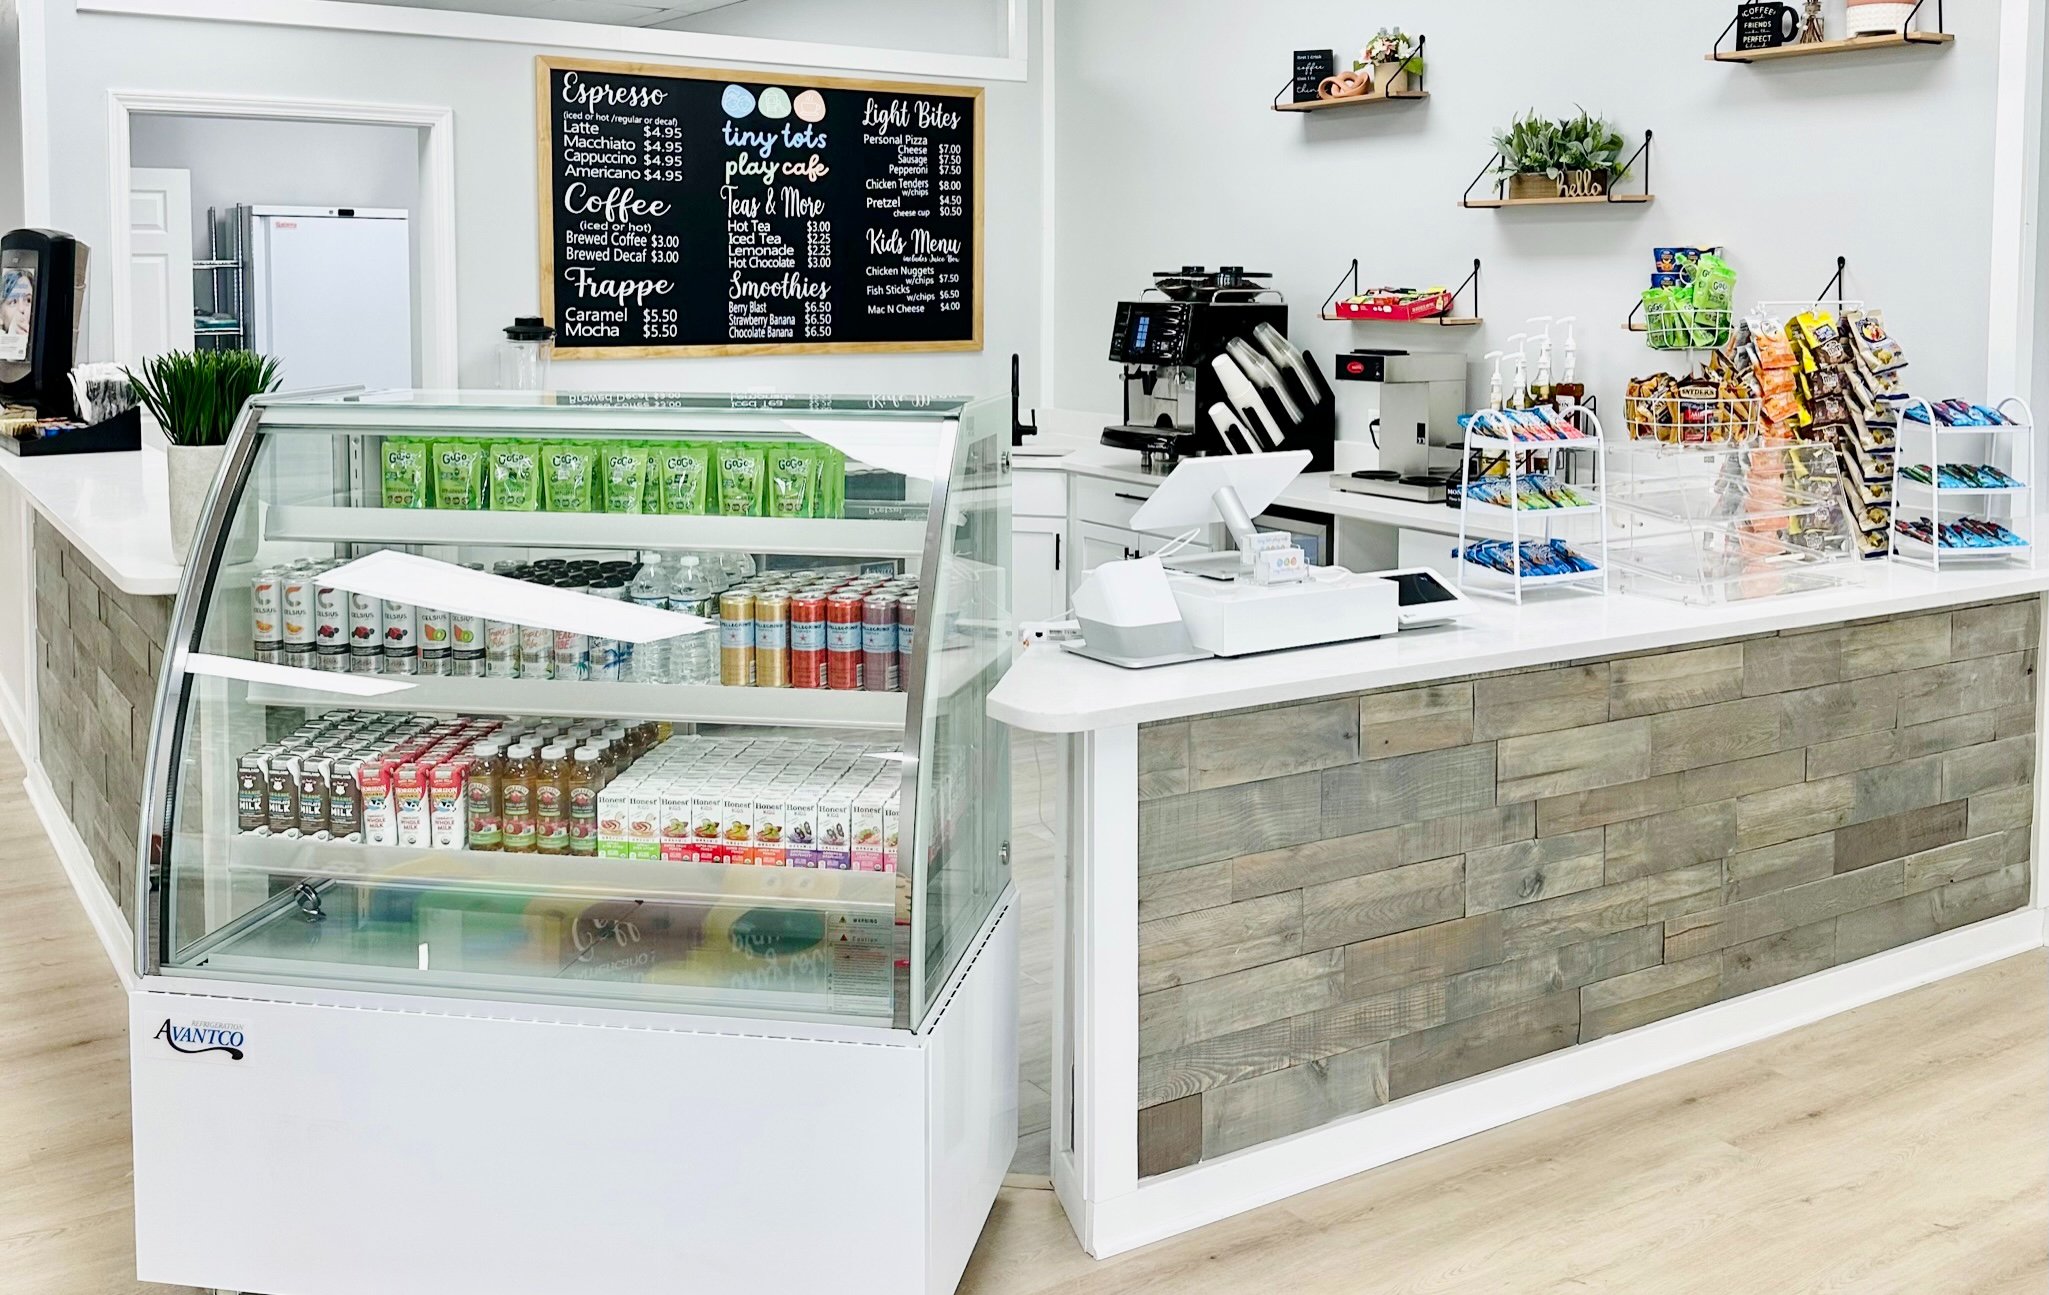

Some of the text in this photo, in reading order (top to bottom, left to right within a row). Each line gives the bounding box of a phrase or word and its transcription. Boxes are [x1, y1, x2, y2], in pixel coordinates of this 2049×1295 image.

[1744, 6, 1773, 16] COFFEE
[1743, 35, 1772, 43] PERFECT
[1297, 62, 1324, 75] coffee
[562, 72, 668, 113] Espresso
[564, 111, 582, 120] (iced
[596, 113, 609, 122] hot
[611, 115, 642, 125] /regular
[655, 117, 677, 127] decaf)
[862, 97, 961, 135] Light Bites
[564, 120, 682, 138] Latte $4.95
[564, 135, 683, 153] Macchiato $4.95
[722, 120, 827, 158] tiny tots
[863, 134, 928, 145] Personal Pizza
[898, 144, 961, 154] Cheese $7.00
[564, 149, 683, 167] Cappuccino $4.95
[898, 155, 961, 166] Sausage $7.50
[565, 164, 683, 181] Americano $4.95
[726, 152, 829, 185] play cafe
[889, 164, 961, 176] Pepperoni $7.50
[866, 178, 961, 191] Chicken Tenders $8.00
[1557, 168, 1602, 197] hello
[902, 188, 928, 197] w/chips
[564, 182, 671, 223] Coffee
[720, 185, 825, 218] Teas & More
[867, 195, 962, 208] Pretzel $4.50
[893, 206, 962, 218] cheese cup $0.50
[580, 220, 608, 231] (iced
[628, 223, 651, 234] hot)
[728, 220, 830, 232] Hot Tea $3.00
[566, 230, 679, 248] Brewed Coffee $3.00
[728, 232, 831, 244] Iced Tea $2.25
[866, 228, 961, 254] Kids Menu
[566, 247, 679, 263] Brewed Decaf $3.00
[729, 244, 831, 256] Lemonade $2.25
[729, 256, 831, 268] Hot Chocolate $3.00
[866, 266, 934, 277] Chicken Nuggets
[564, 267, 674, 306] Frappe
[729, 270, 831, 299] Smoothies
[906, 274, 959, 286] w/chips $7.50
[867, 284, 910, 295] Fish Sticks
[907, 290, 960, 302] w/chips $6.50
[729, 301, 831, 316] Berry Blast $6.50
[868, 302, 960, 314] Mac N Cheese $4.00
[565, 307, 678, 323] Caramel $5.50
[729, 313, 831, 328] Strawberry Banana $6.50
[565, 322, 678, 339] Mocha $5.50
[729, 326, 831, 338] Chocolate Banana $6.50
[240, 802, 261, 810] MILK
[269, 804, 290, 812] MILK
[301, 806, 321, 814] MILK
[331, 808, 352, 816] MILK
[192, 1020, 244, 1030] REFRIGERATION
[153, 1018, 244, 1054] AVANTCO
